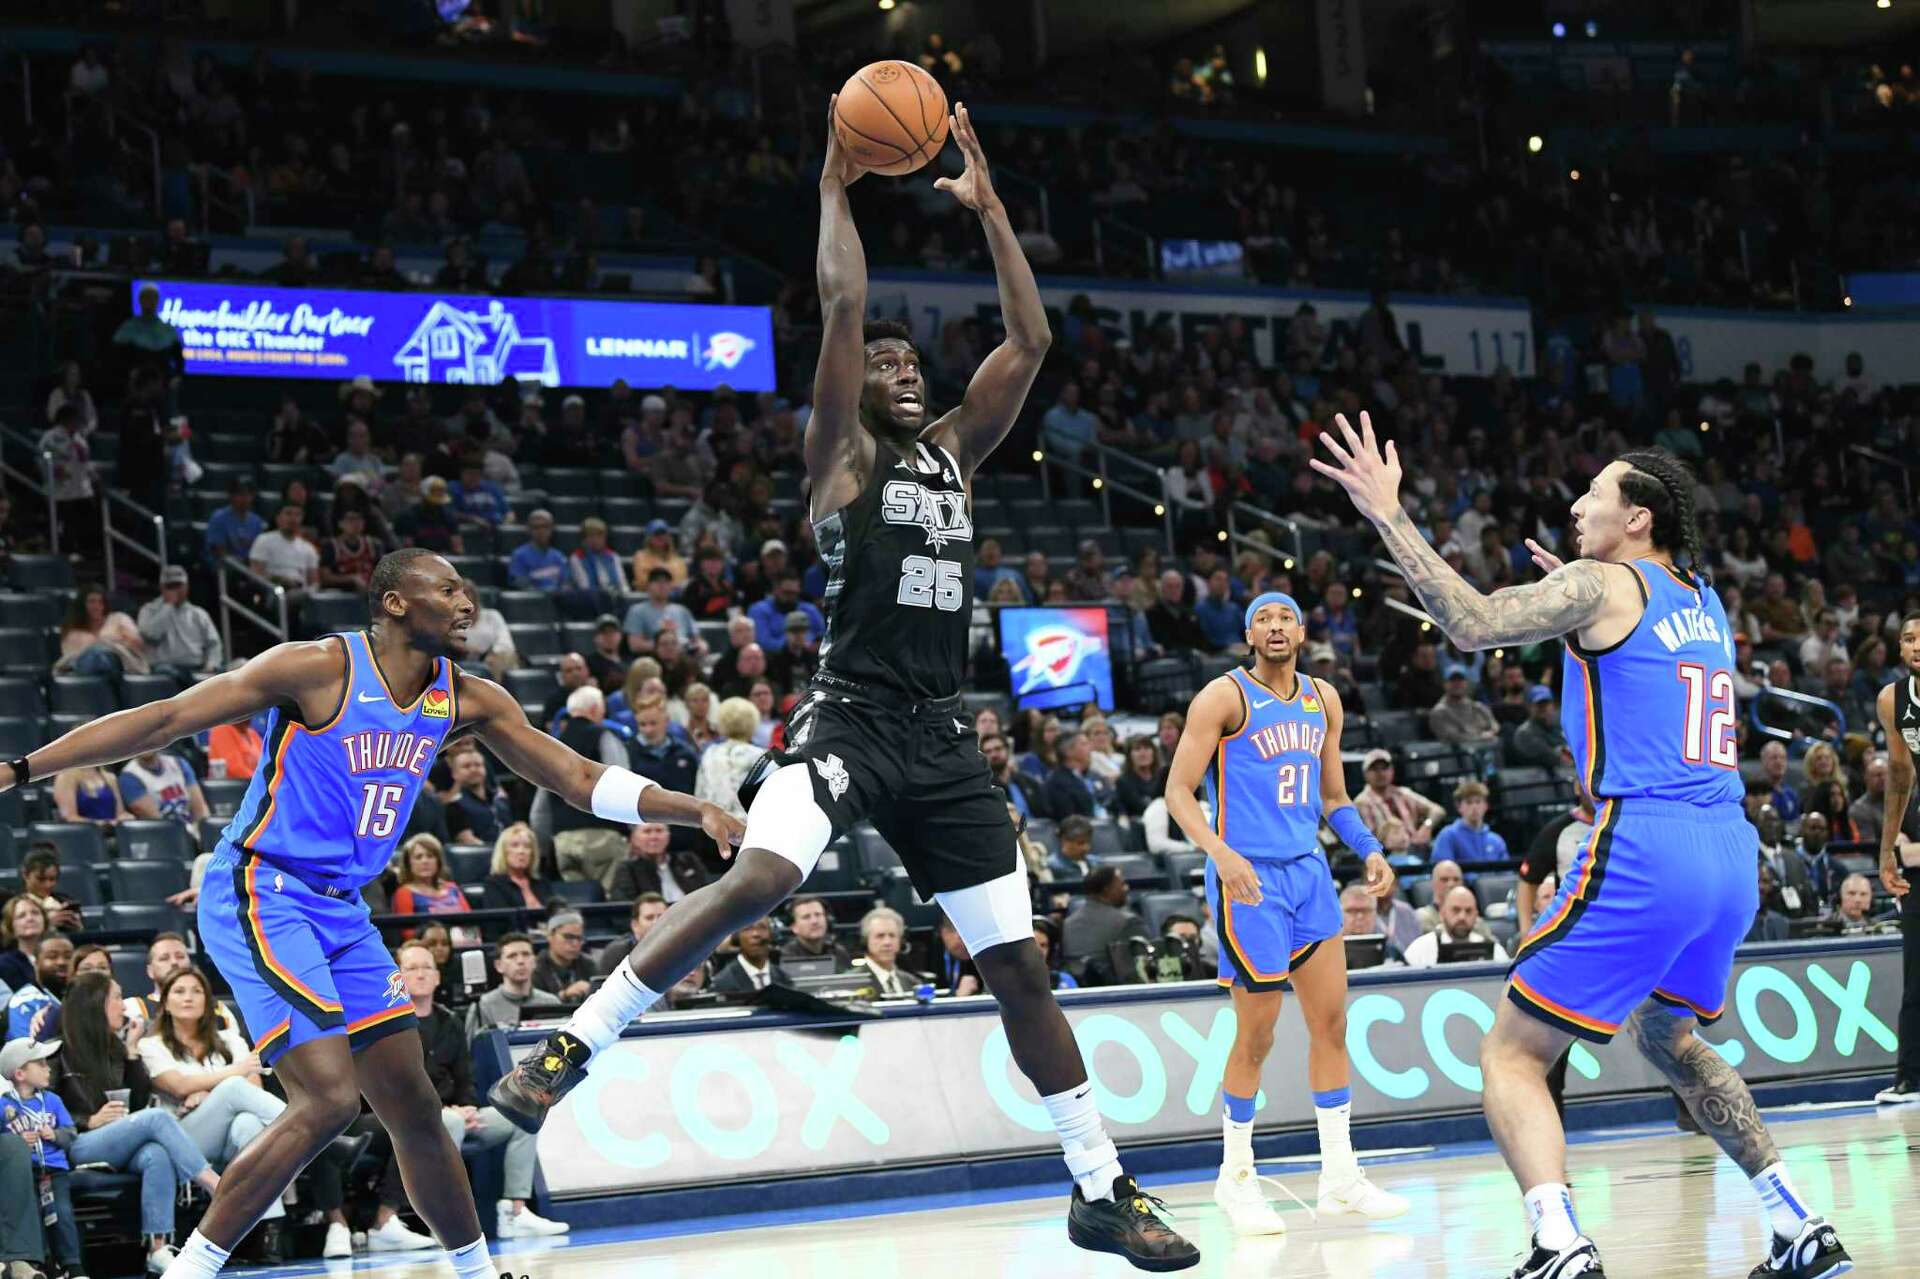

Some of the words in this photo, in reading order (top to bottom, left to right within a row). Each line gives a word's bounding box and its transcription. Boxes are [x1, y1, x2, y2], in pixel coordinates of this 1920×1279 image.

[253, 331, 326, 351] Thunder
[290, 303, 375, 337] Partner
[585, 336, 689, 360] LENNAR
[897, 554, 963, 612] 25
[423, 705, 448, 717] Love's
[1677, 661, 1738, 772] 12
[1277, 763, 1311, 806] 21
[356, 783, 404, 839] 15
[1695, 960, 1899, 1067] OX
[572, 1034, 890, 1169] COX
